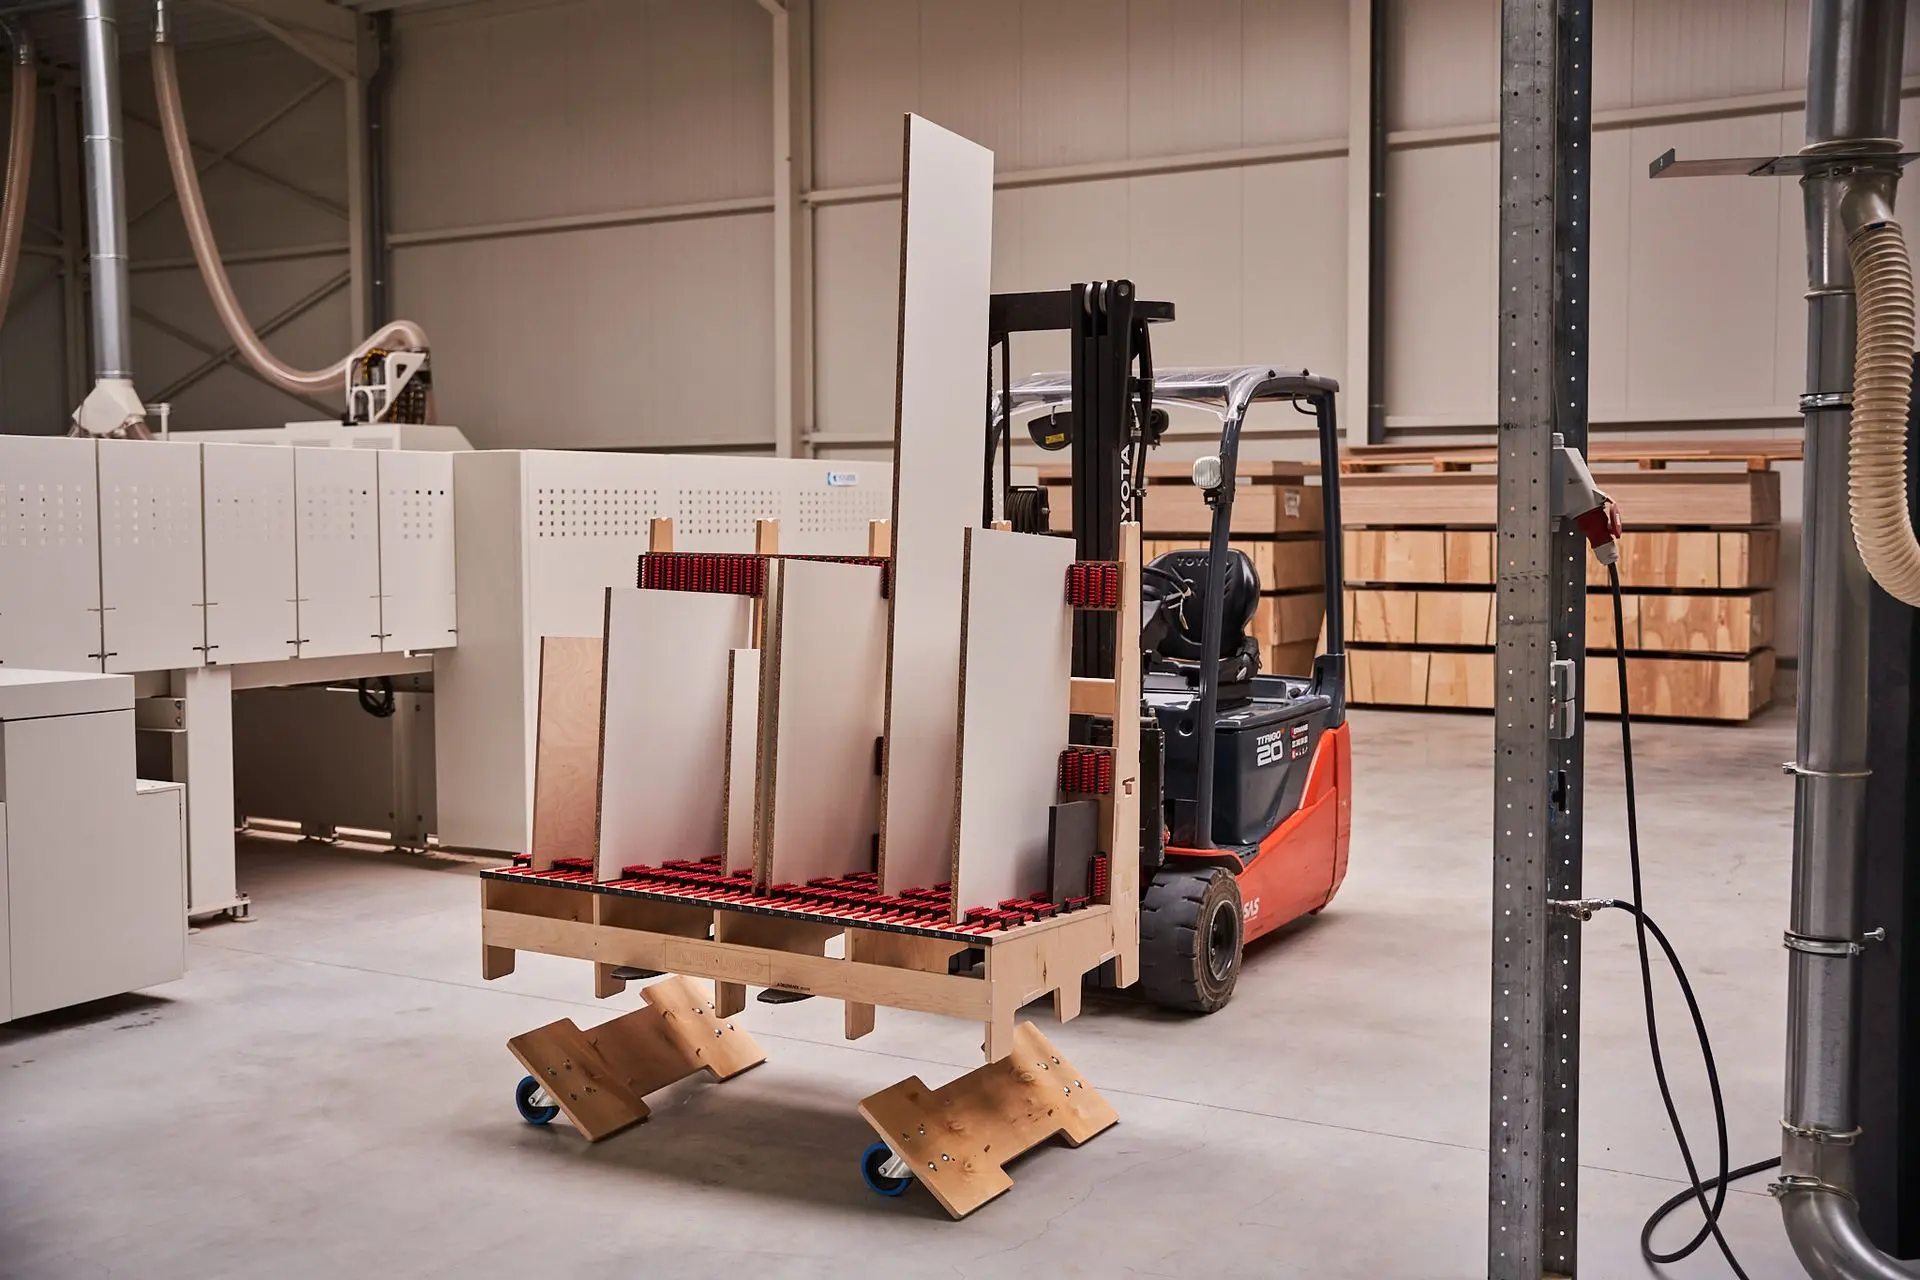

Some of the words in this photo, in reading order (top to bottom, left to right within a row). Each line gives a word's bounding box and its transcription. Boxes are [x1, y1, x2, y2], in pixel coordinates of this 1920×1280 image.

[1120, 444, 1130, 521] YOTA
[1257, 740, 1283, 767] 20
[1243, 897, 1260, 919] SAS
